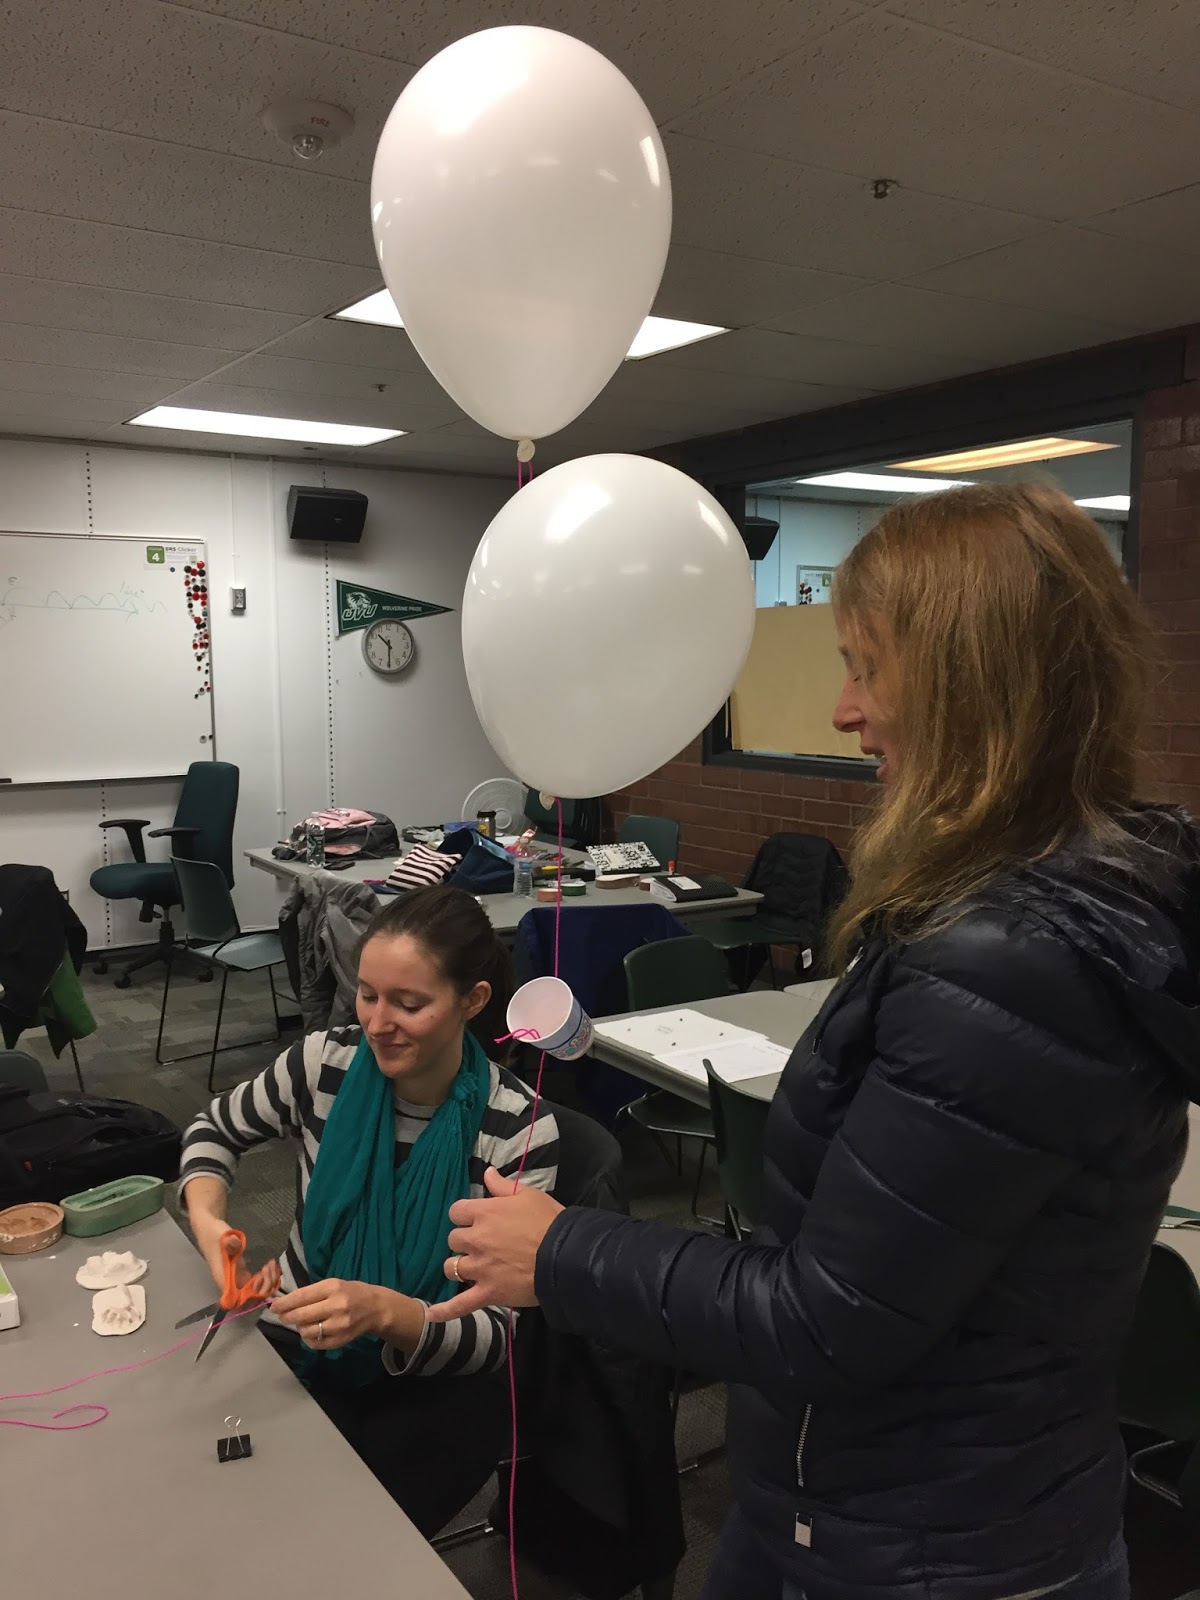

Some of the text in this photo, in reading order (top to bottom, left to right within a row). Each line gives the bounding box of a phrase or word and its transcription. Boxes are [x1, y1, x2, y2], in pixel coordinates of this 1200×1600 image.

[310, 116, 330, 127] FIRE
[152, 553, 160, 562] 4
[341, 604, 378, 620] UVU
